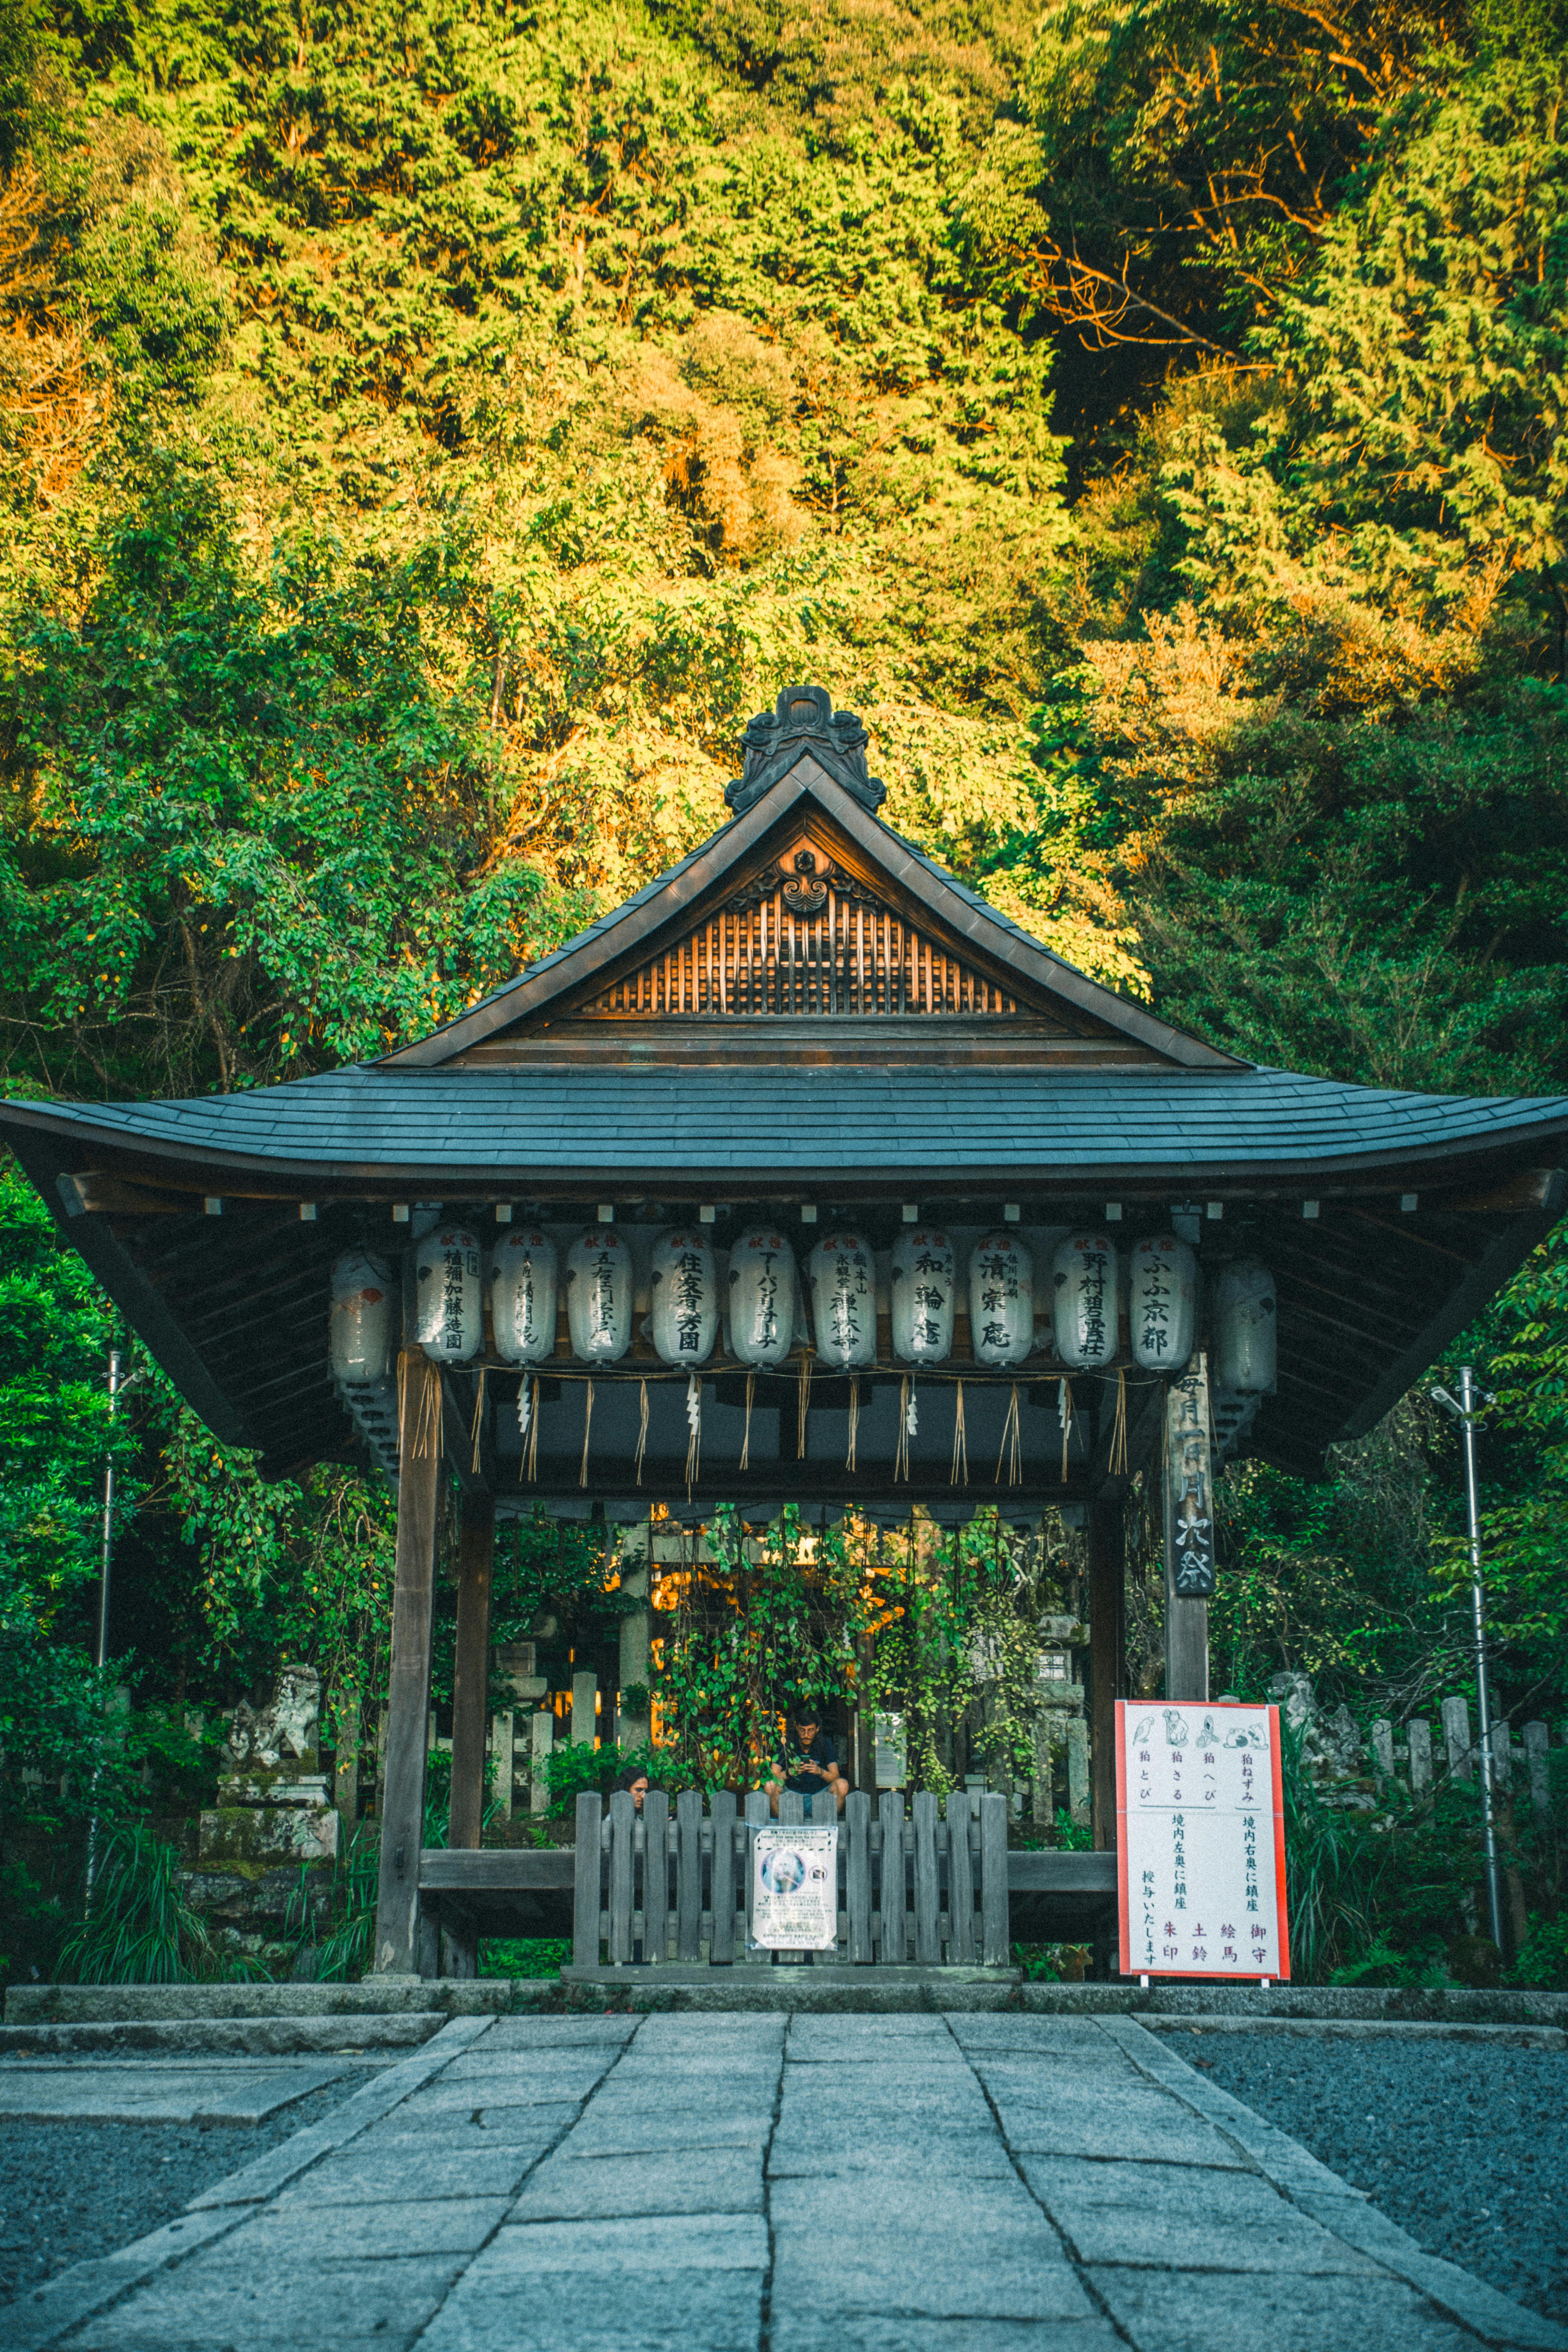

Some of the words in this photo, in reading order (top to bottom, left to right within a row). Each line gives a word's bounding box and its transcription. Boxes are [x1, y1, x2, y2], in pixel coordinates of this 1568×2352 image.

[675, 1252, 704, 1351] 住友有芳園
[757, 1251, 778, 1349] アーバンリサーチ
[1141, 1255, 1170, 1357] ふふ京都
[1139, 1751, 1152, 1799] 狛とび
[1171, 1752, 1183, 1801] 狛さる
[1204, 1753, 1216, 1801] 狛へび
[1242, 1754, 1254, 1802] 狛ねずみ
[1171, 1814, 1187, 1910] 境内左奥に鎮座
[1242, 1816, 1259, 1912] 境内右奥に鎮座
[1141, 1870, 1156, 1966] 授与いたします
[1163, 1921, 1179, 1961] 朱印
[1191, 1923, 1208, 1962] 土鈴
[1220, 1923, 1237, 1963] 絵馬
[1250, 1924, 1267, 1964] 御守
